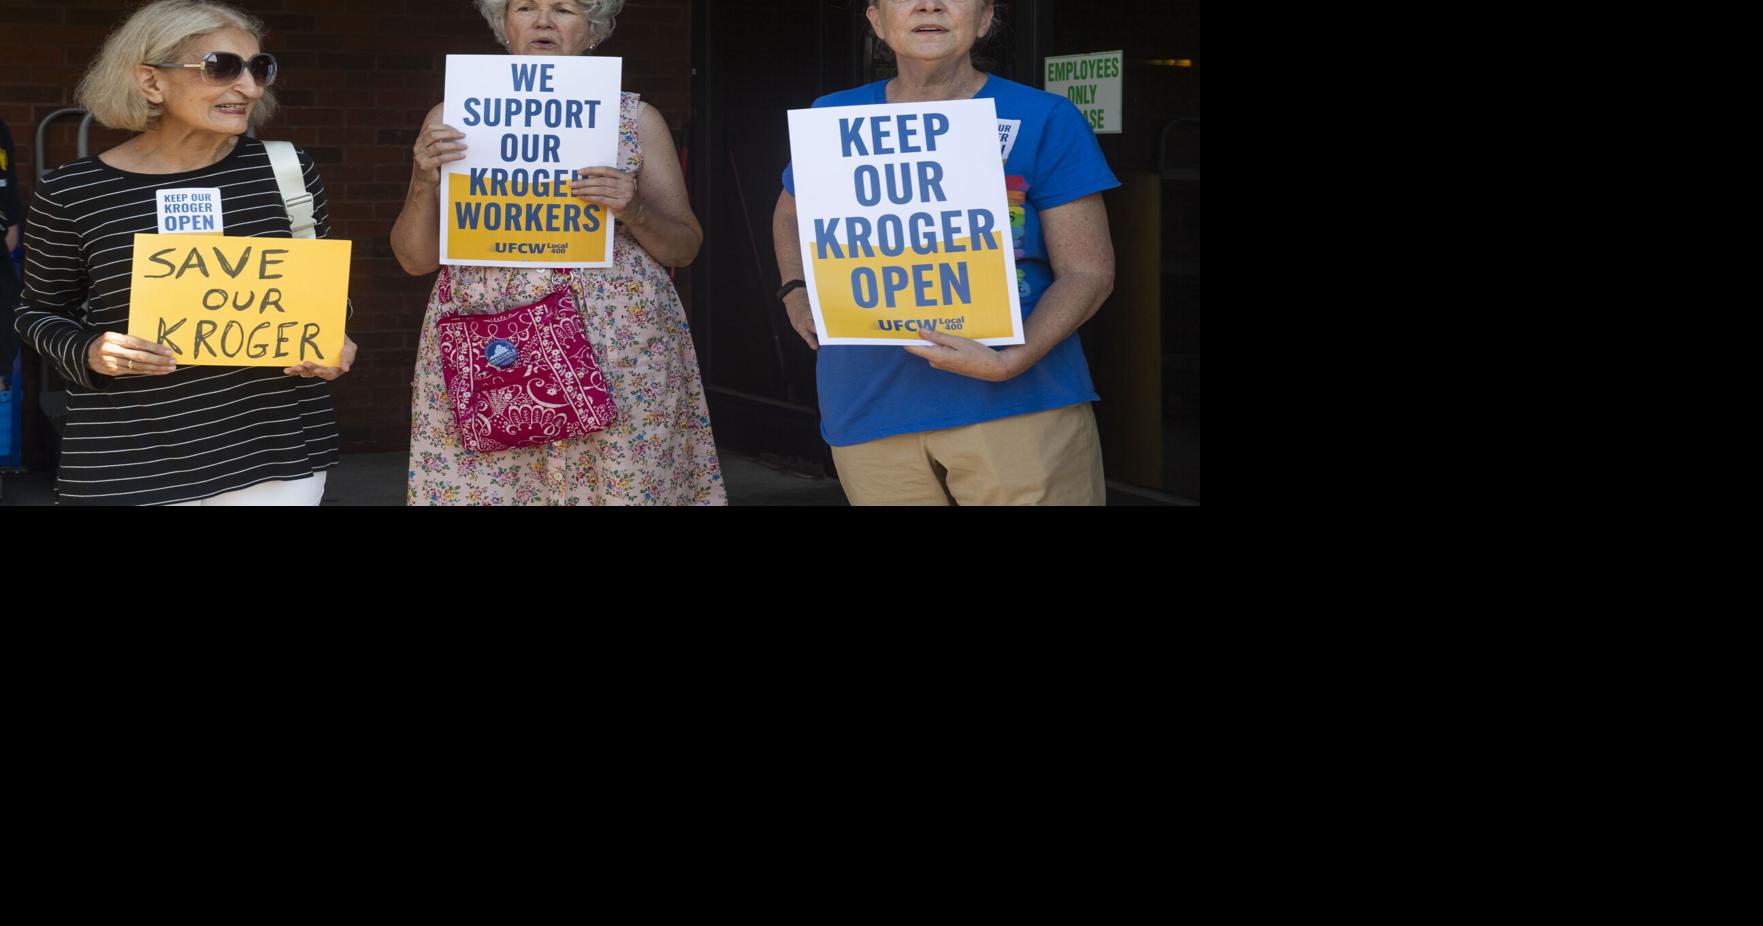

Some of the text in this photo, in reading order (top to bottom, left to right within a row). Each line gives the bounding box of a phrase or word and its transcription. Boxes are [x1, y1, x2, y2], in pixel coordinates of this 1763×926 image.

[511, 63, 555, 92] WE
[1047, 57, 1119, 82] EMPLOYEES
[463, 97, 601, 129] SUPPORT
[500, 133, 561, 163] OUR
[838, 112, 950, 158] KEEP
[164, 193, 212, 202] KEEP OUR
[853, 160, 947, 207] OUR
[164, 202, 213, 213] KROGER
[164, 214, 214, 231] OPEN
[455, 201, 601, 232] WORKERS
[495, 242, 546, 254] UFCW
[814, 208, 999, 259] KROGER
[144, 246, 289, 279] SAVE
[851, 261, 972, 309] OPEN
[202, 287, 285, 314] OUR
[878, 315, 964, 332] UFCW Local
[156, 317, 325, 361] KROGER
